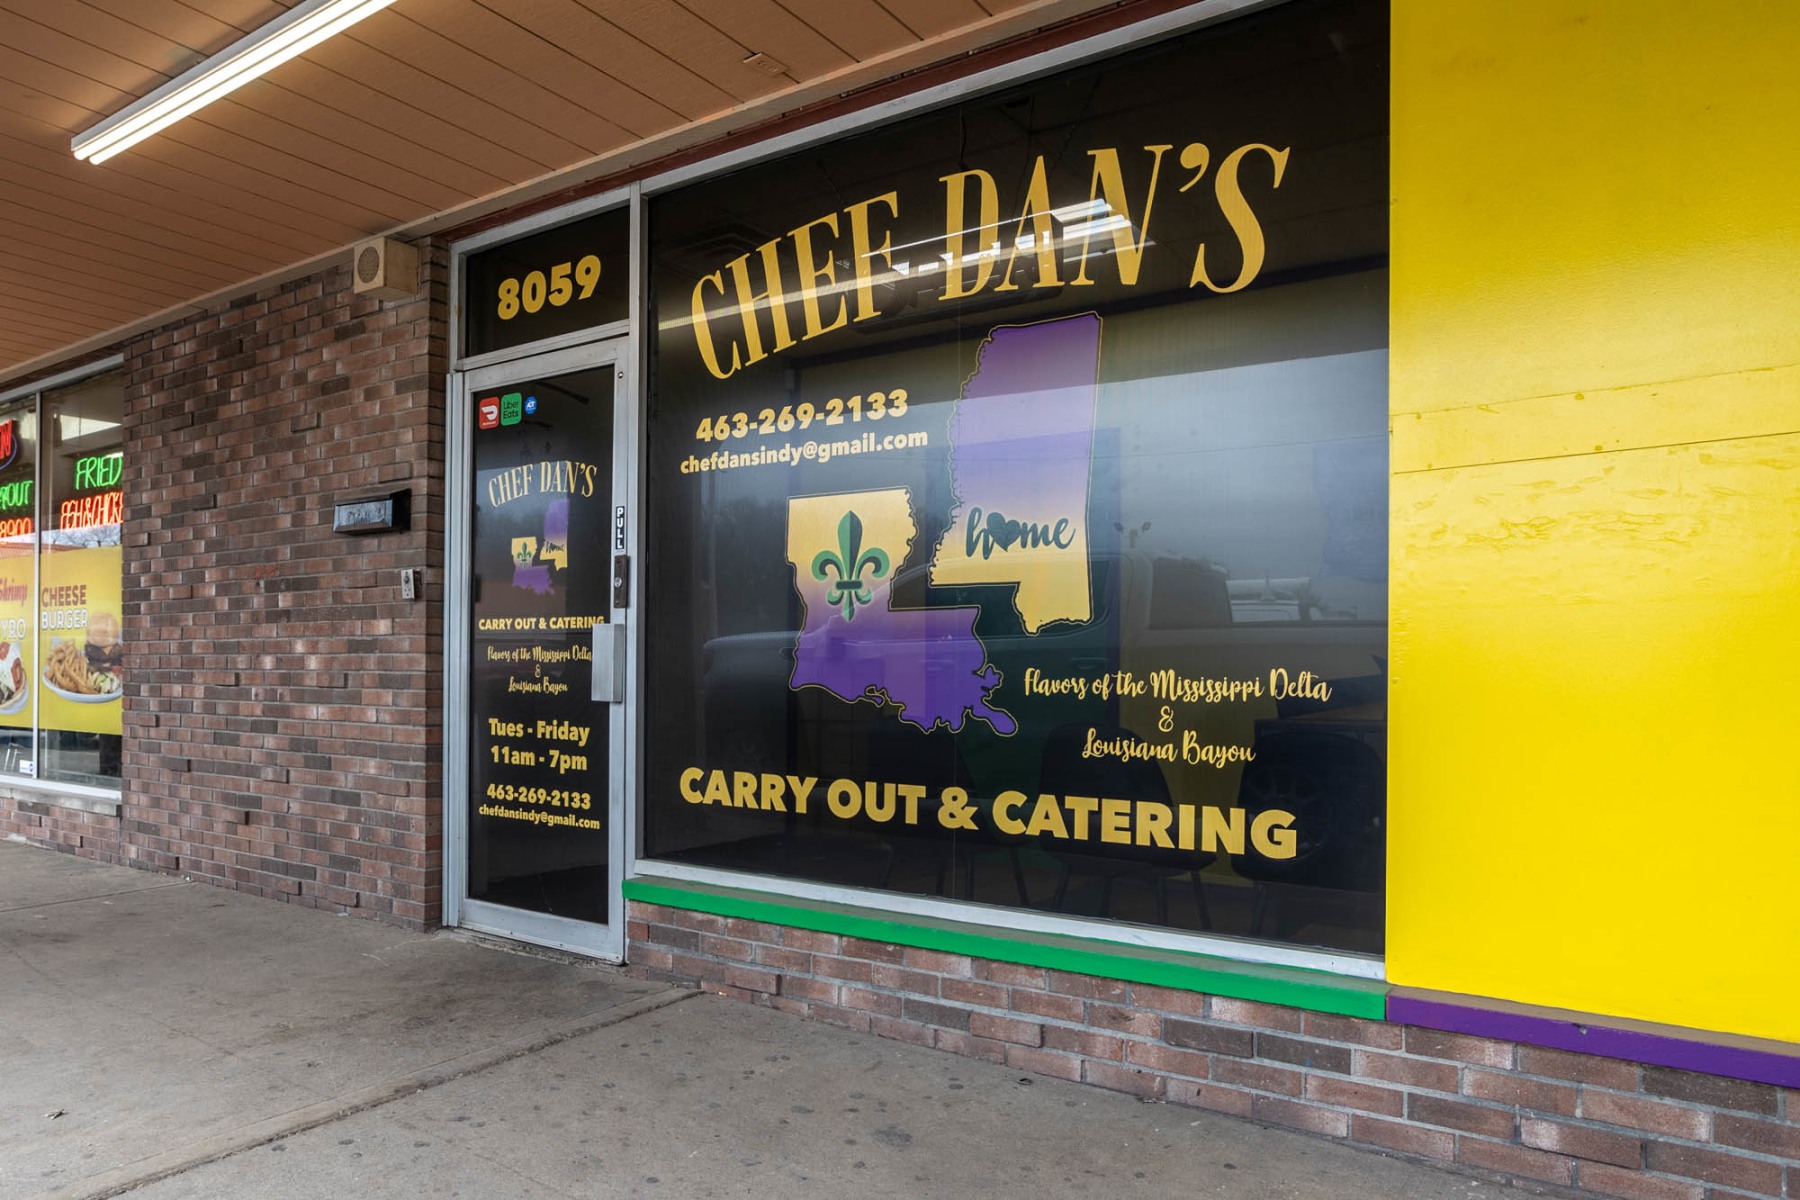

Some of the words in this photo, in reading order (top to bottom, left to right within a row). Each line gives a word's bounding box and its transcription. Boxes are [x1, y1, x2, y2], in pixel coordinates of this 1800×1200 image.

[690, 191, 901, 380] CHEF
[938, 142, 1291, 295] DAN'S
[497, 255, 601, 321] 8059
[503, 410, 519, 419] Eats
[695, 388, 908, 443] 463-269-2133
[680, 431, 929, 474] chefdansindy@gmail.com
[75, 456, 122, 490] FRIED
[488, 463, 533, 508] CHEF
[540, 460, 597, 498] DAN'S
[616, 507, 624, 549] PULL
[41, 584, 87, 607] CHEESE
[0, 618, 26, 639] YRO
[41, 608, 89, 630] BURGER
[478, 618, 513, 630] CARRY
[514, 617, 537, 630] OUT
[538, 617, 547, 629] &
[487, 645, 510, 662] Flavors
[511, 647, 519, 662] of
[520, 645, 532, 661] the
[532, 645, 570, 662] Mississippi
[534, 663, 541, 678] &
[1023, 667, 1090, 700] Flavors
[1091, 673, 1115, 700] of
[1112, 670, 1149, 697] the
[1149, 669, 1266, 702] Mississippi
[1268, 667, 1333, 701] Delta
[508, 676, 542, 693] Louisiana
[543, 676, 568, 695] Bayou
[488, 718, 525, 738] Tues
[536, 719, 590, 747] Friday
[1157, 705, 1174, 732] &
[490, 745, 535, 767] 11am
[548, 749, 588, 774] 7pm
[1081, 727, 1179, 762] Louisiana
[1181, 730, 1257, 768] Bayou
[486, 783, 592, 810] 463-269-2133
[478, 803, 601, 830] chefdansindy@gmail.com
[679, 767, 818, 815] CARRY
[826, 778, 927, 825] OUT
[937, 786, 979, 831] &
[992, 790, 1298, 860] CATERING
